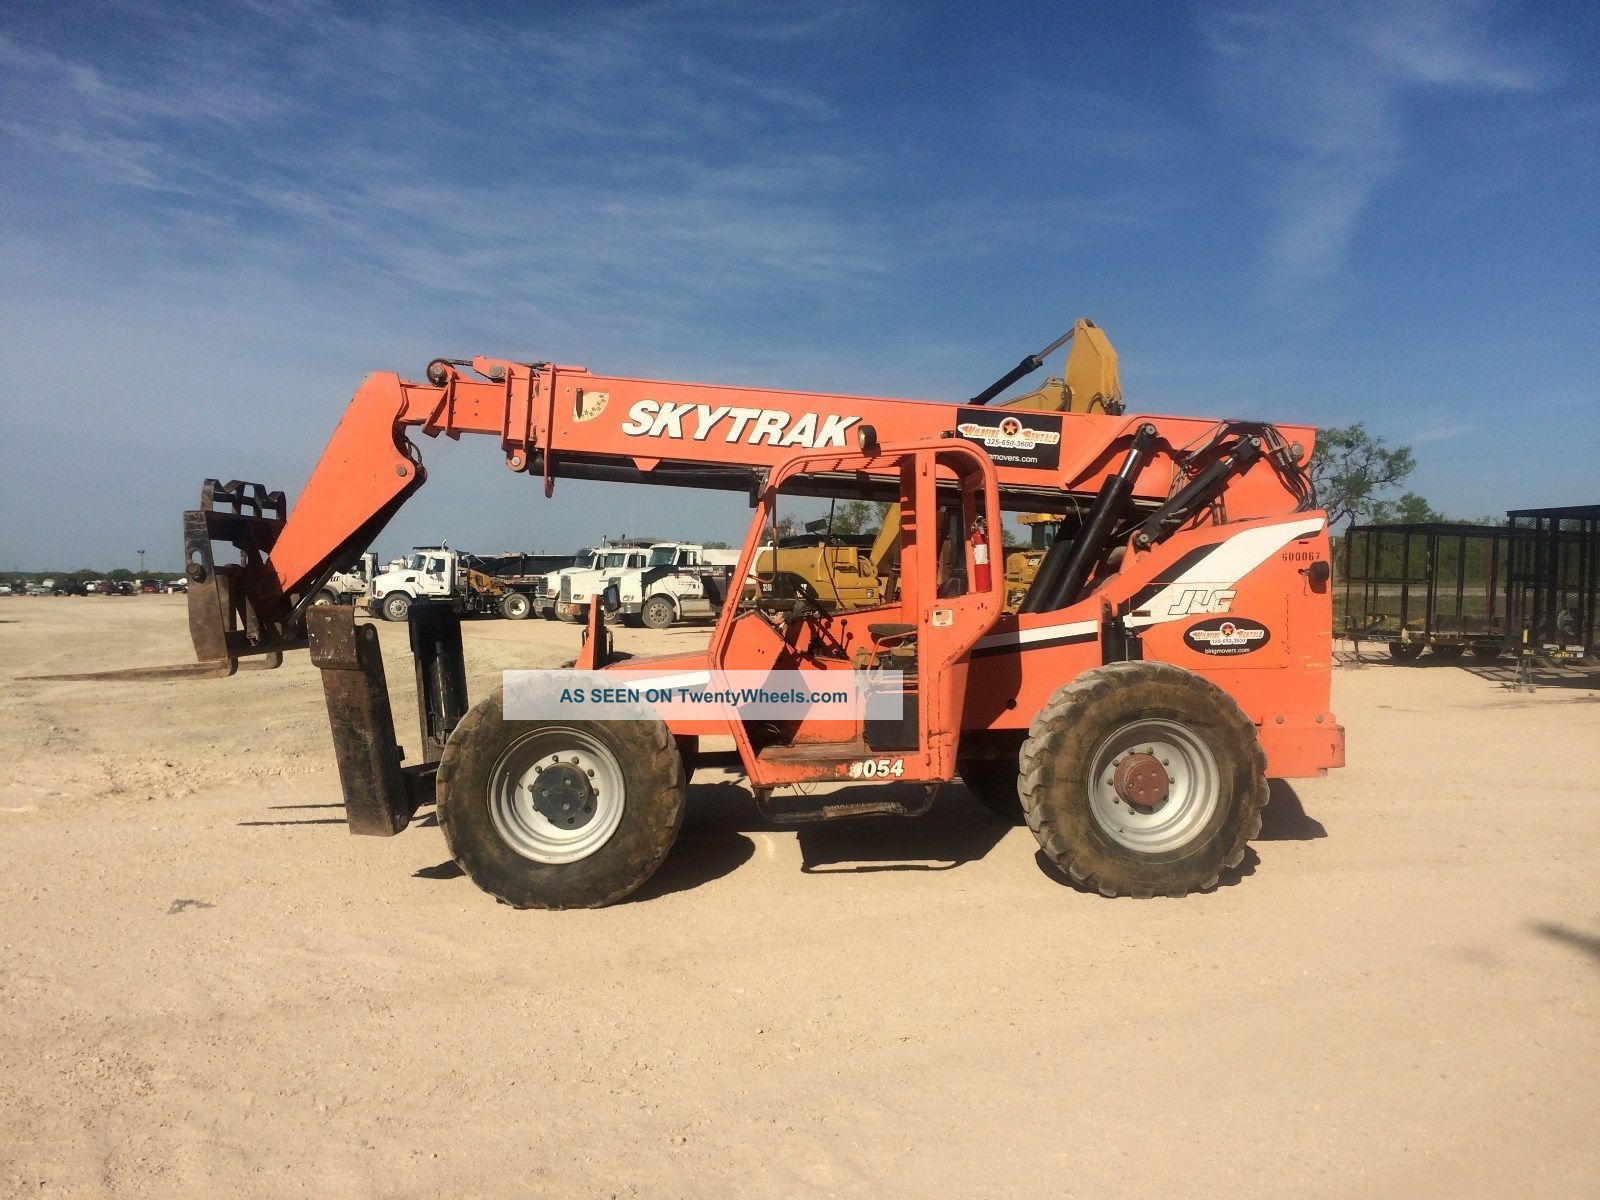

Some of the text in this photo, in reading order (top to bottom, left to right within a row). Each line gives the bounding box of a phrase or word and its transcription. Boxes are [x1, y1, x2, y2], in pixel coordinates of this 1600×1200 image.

[621, 399, 863, 448] SKYTRAK
[986, 439, 1034, 448] 325-650-3600
[1282, 552, 1320, 561] 600067
[1167, 589, 1238, 615] JLG
